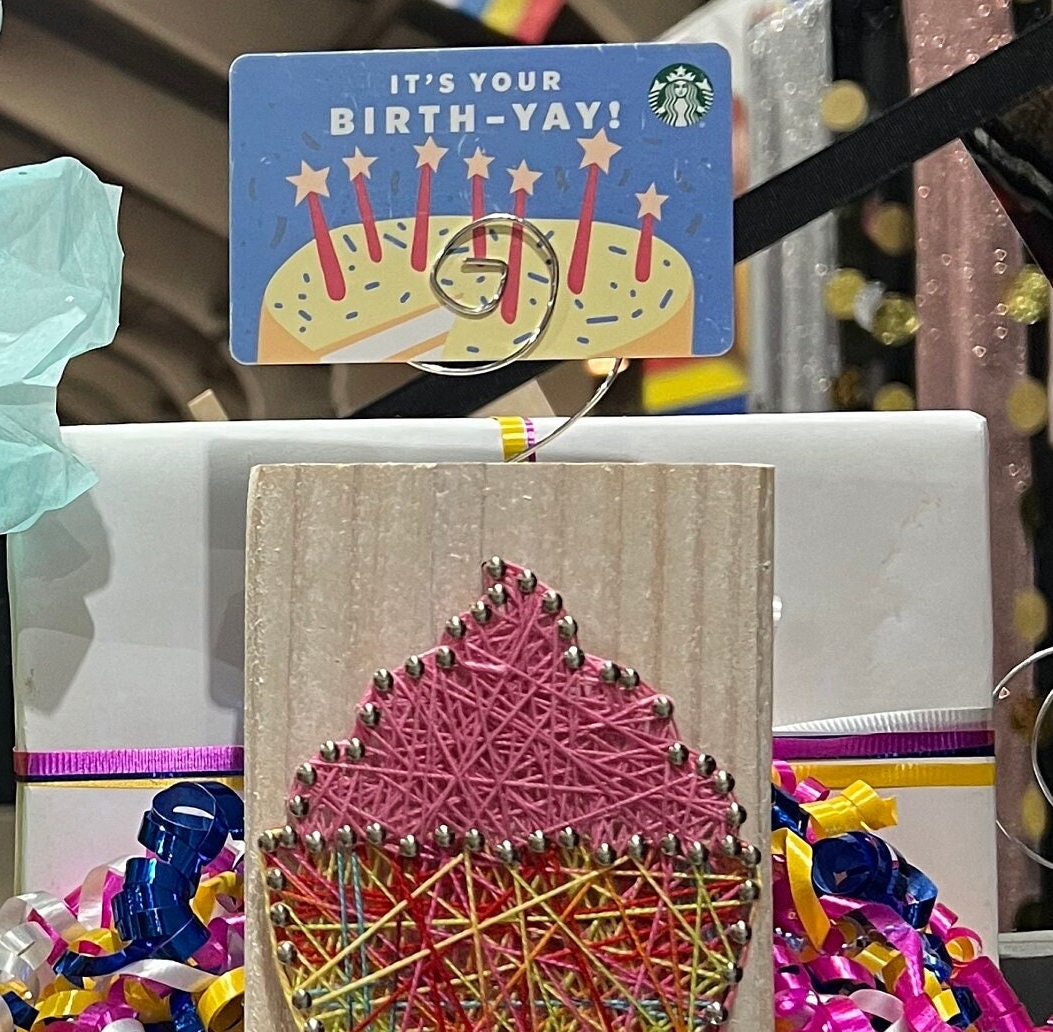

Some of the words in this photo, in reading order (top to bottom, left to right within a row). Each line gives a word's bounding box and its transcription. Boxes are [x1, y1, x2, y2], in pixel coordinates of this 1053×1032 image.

[390, 72, 456, 94] IT'S
[469, 71, 561, 92] YOUR
[330, 101, 621, 136] BIRTH-YAY!
